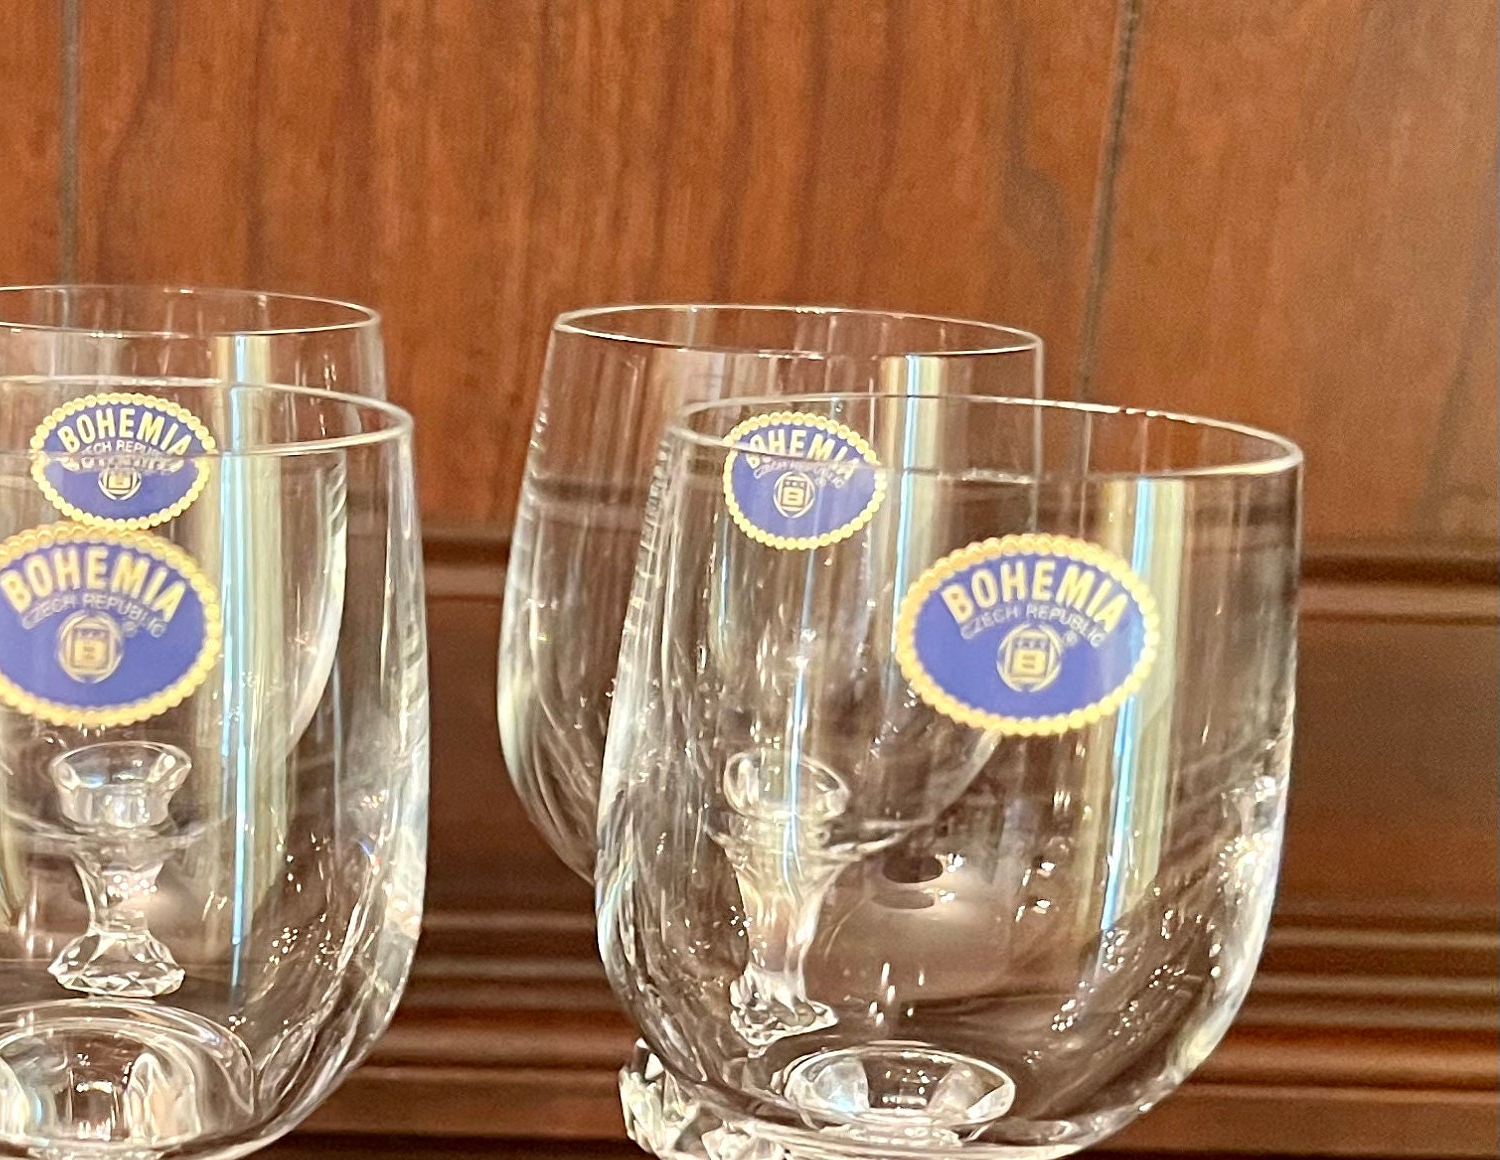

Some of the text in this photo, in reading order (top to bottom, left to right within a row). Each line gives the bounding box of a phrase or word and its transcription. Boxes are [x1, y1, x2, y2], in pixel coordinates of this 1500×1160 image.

[57, 408, 192, 456] BOHEMIA
[82, 592, 168, 638] REPUBLIC
[941, 559, 1128, 633] BOHEMIA
[961, 602, 1108, 647] CZECH REPUBLIC
